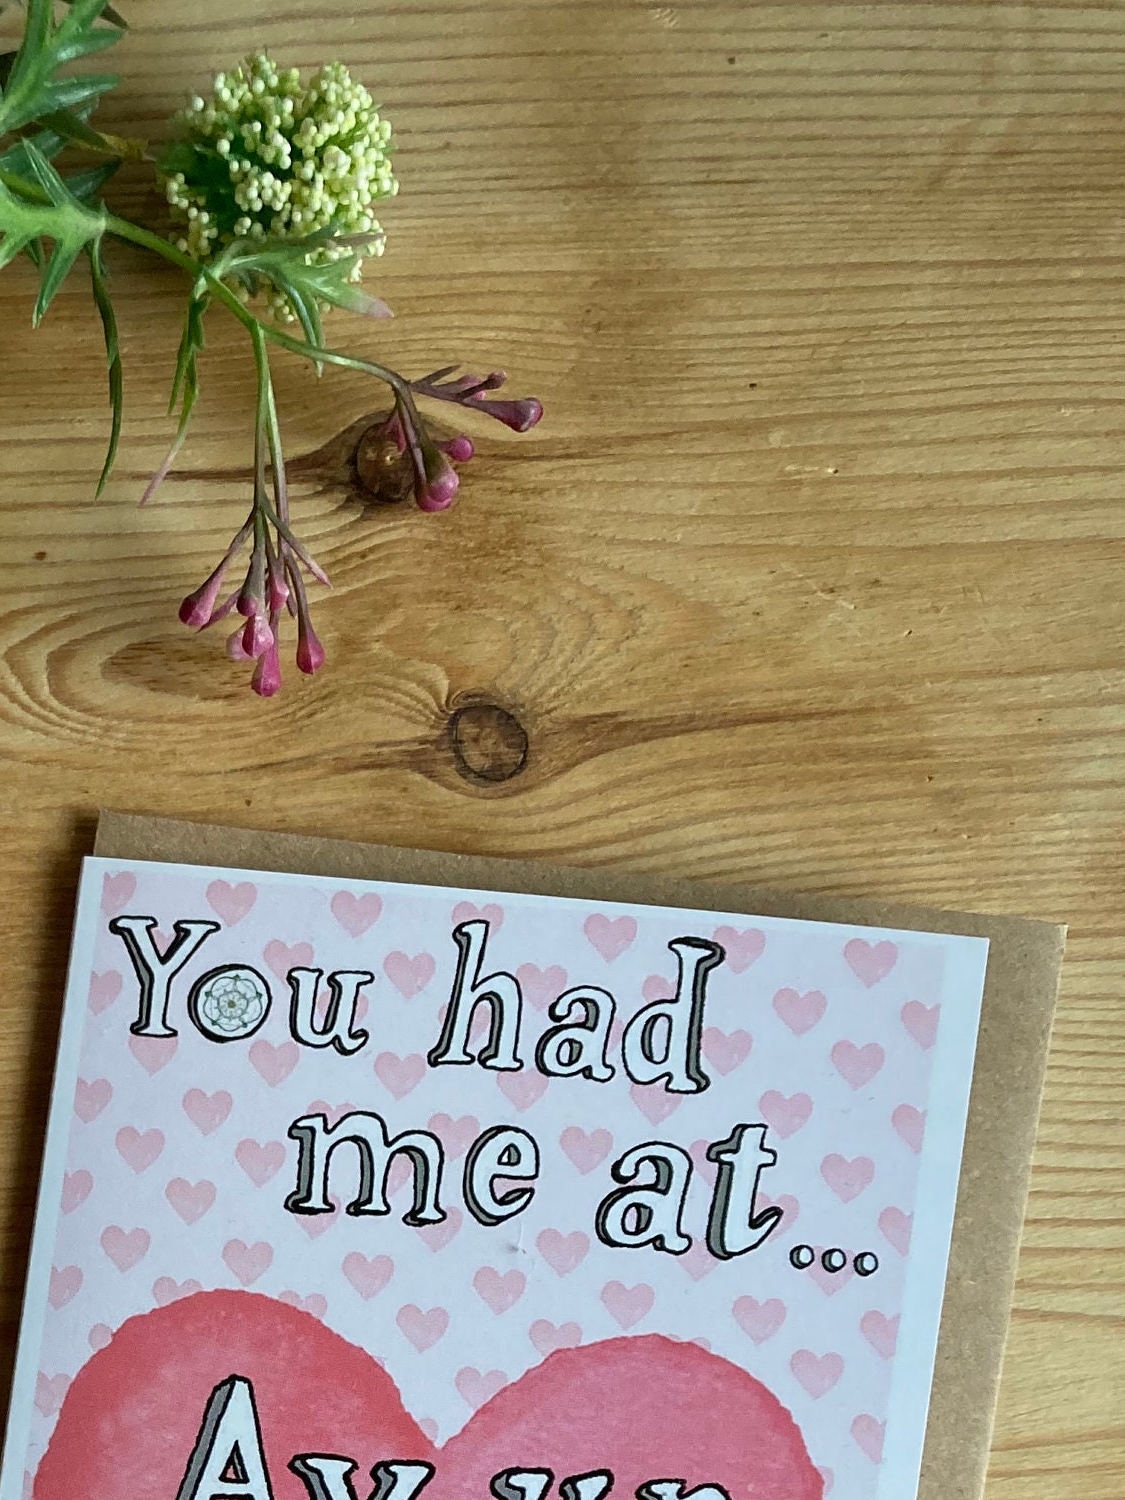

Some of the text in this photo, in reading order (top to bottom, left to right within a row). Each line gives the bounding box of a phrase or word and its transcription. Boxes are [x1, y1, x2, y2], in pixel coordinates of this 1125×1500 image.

[110, 916, 724, 1094] You had
[285, 1109, 878, 1276] me at...
